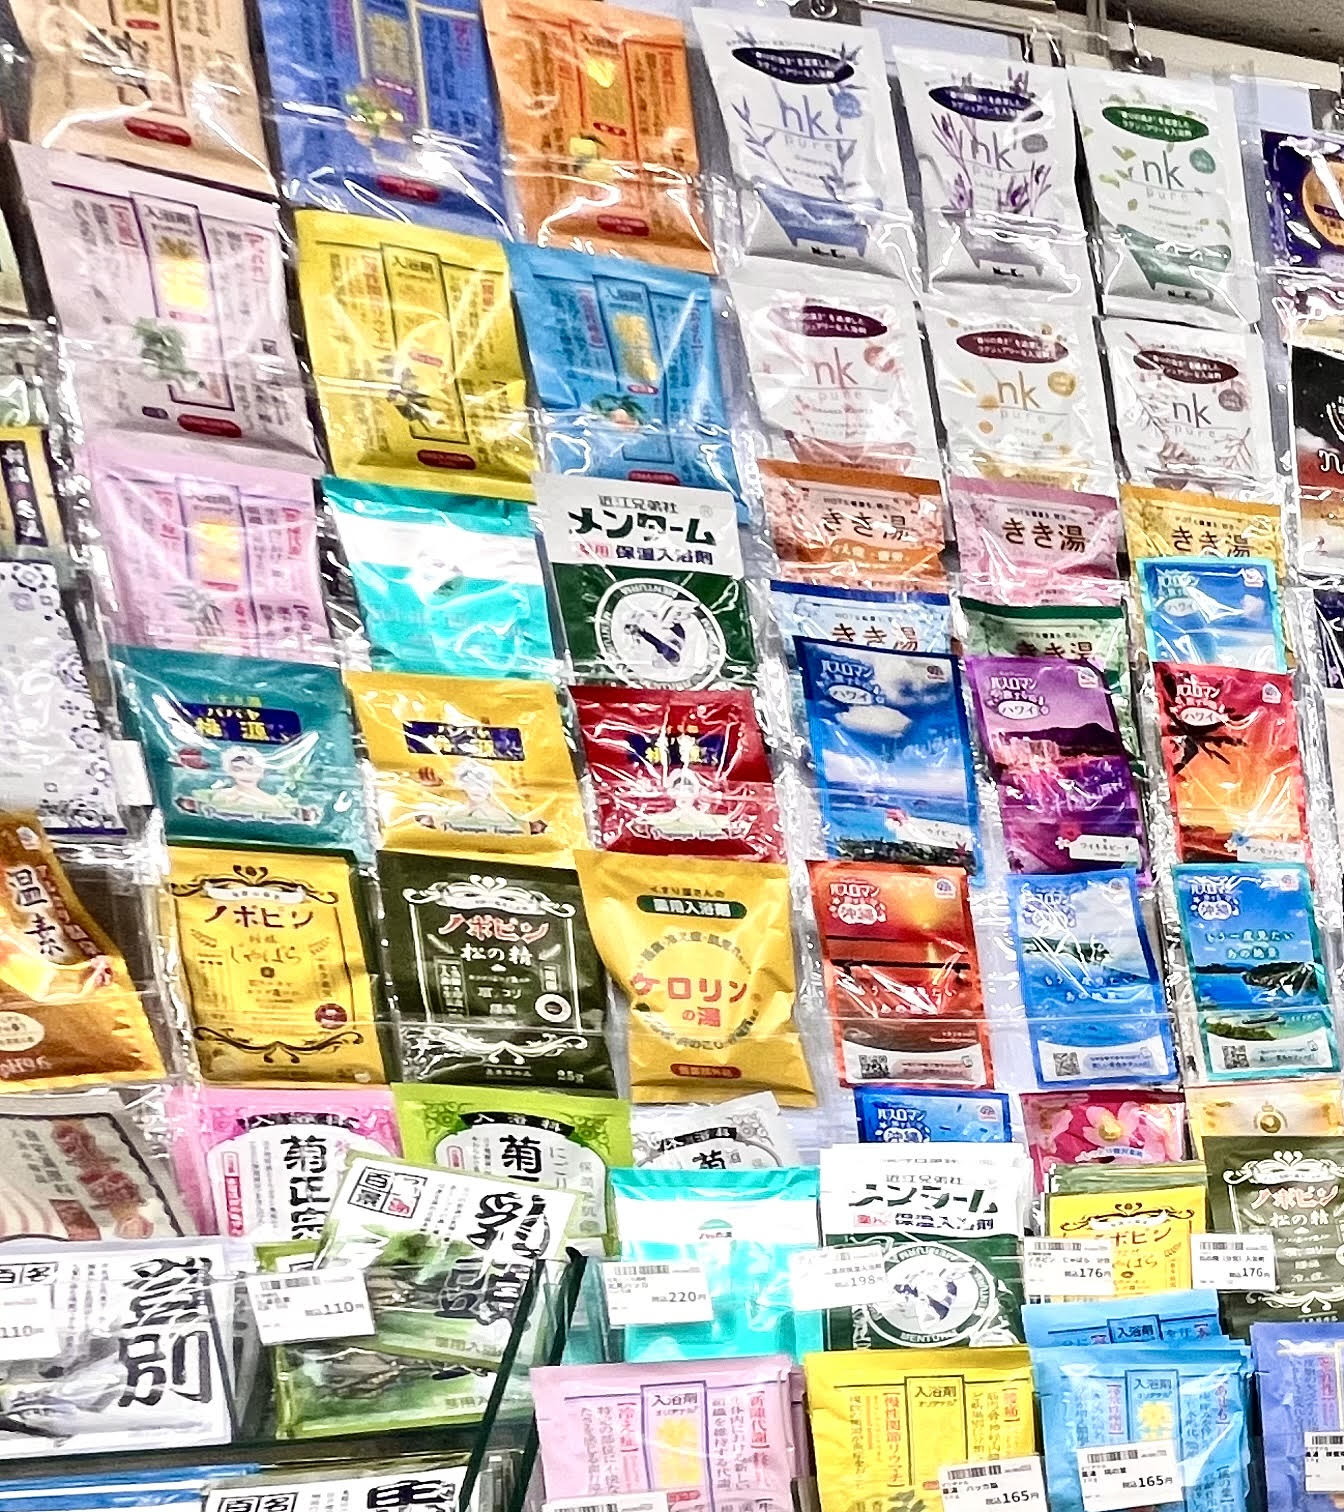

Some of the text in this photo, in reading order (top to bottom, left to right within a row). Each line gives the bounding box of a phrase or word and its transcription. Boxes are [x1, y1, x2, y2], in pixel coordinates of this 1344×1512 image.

[778, 96, 827, 137] nk
[972, 131, 1011, 169] nk
[1145, 151, 1184, 187] nk
[814, 347, 856, 387] nk
[999, 372, 1040, 409] nk
[1173, 394, 1210, 427] nk
[1001, 518, 1087, 554] きき湯
[461, 943, 533, 967] 松の精
[631, 974, 749, 1003] ケロリン
[682, 1006, 721, 1027] の湯
[281, 1134, 329, 1242] 菊正宗
[1064, 1264, 1111, 1279] 税込176円
[1118, 1327, 1154, 1340] 入浴剤
[914, 1385, 957, 1398] 入浴剤
[1133, 1377, 1173, 1391] 入浴剤
[651, 1392, 698, 1406] 入浴剤
[1122, 1474, 1173, 1490] 税込165円
[985, 1489, 1040, 1507] 税込165円
